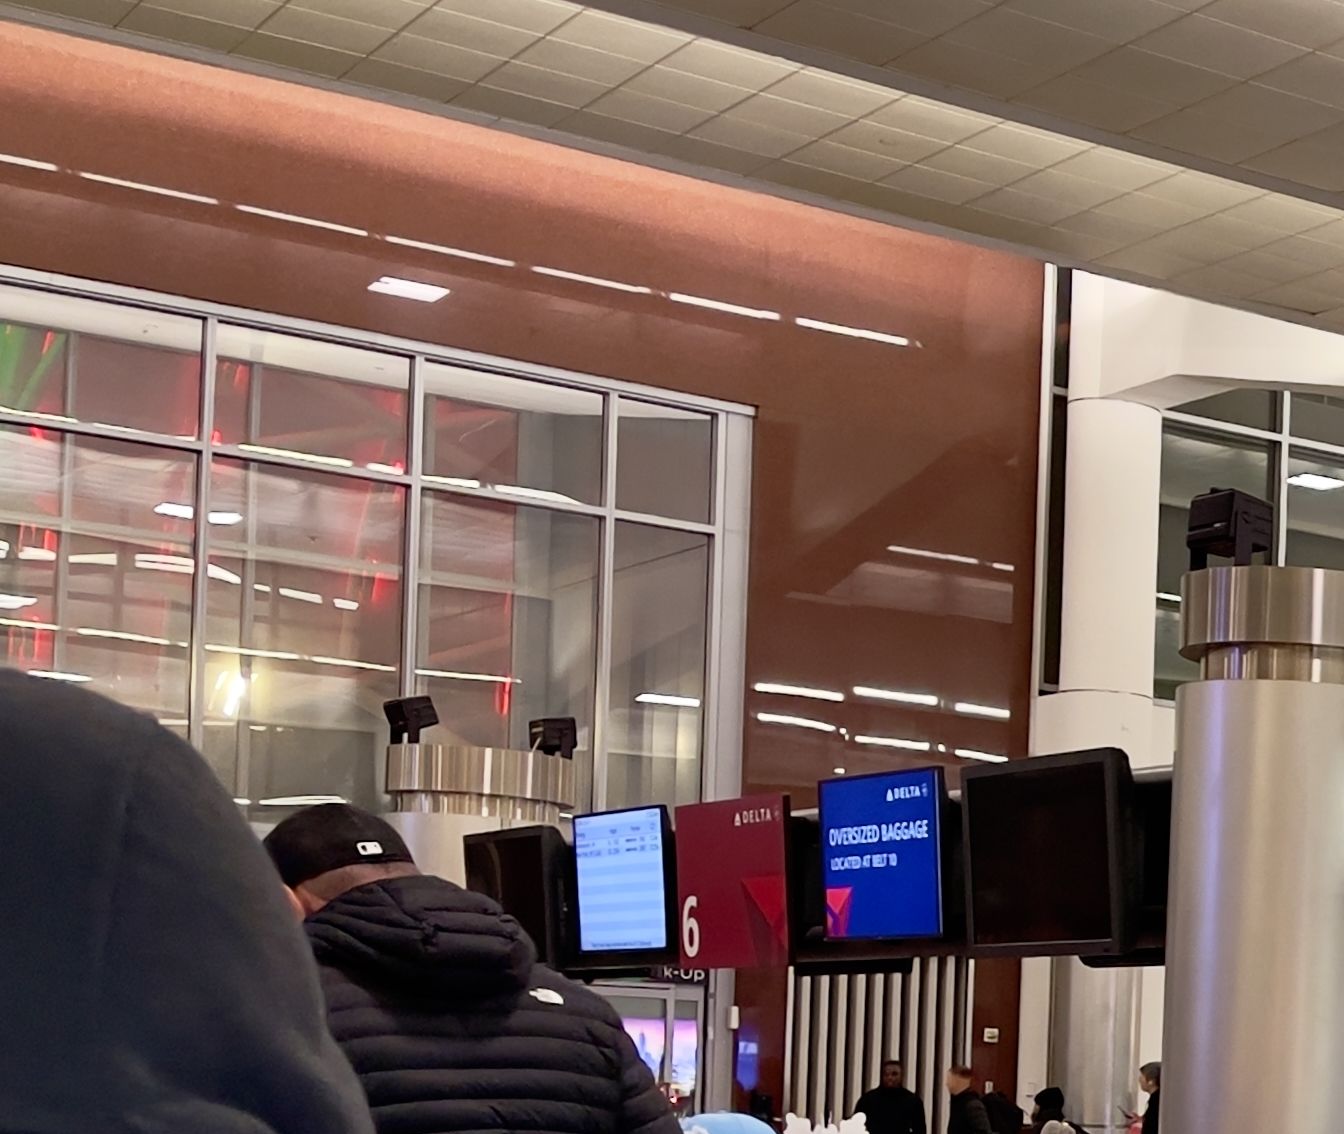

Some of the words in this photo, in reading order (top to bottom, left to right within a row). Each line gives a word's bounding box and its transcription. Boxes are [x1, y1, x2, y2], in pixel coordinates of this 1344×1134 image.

[742, 807, 772, 824] DELTA
[828, 824, 880, 846] OVERSIZED
[881, 819, 929, 842] BAGGAGE
[682, 895, 700, 958] 6
[664, 966, 706, 982] k-Up
